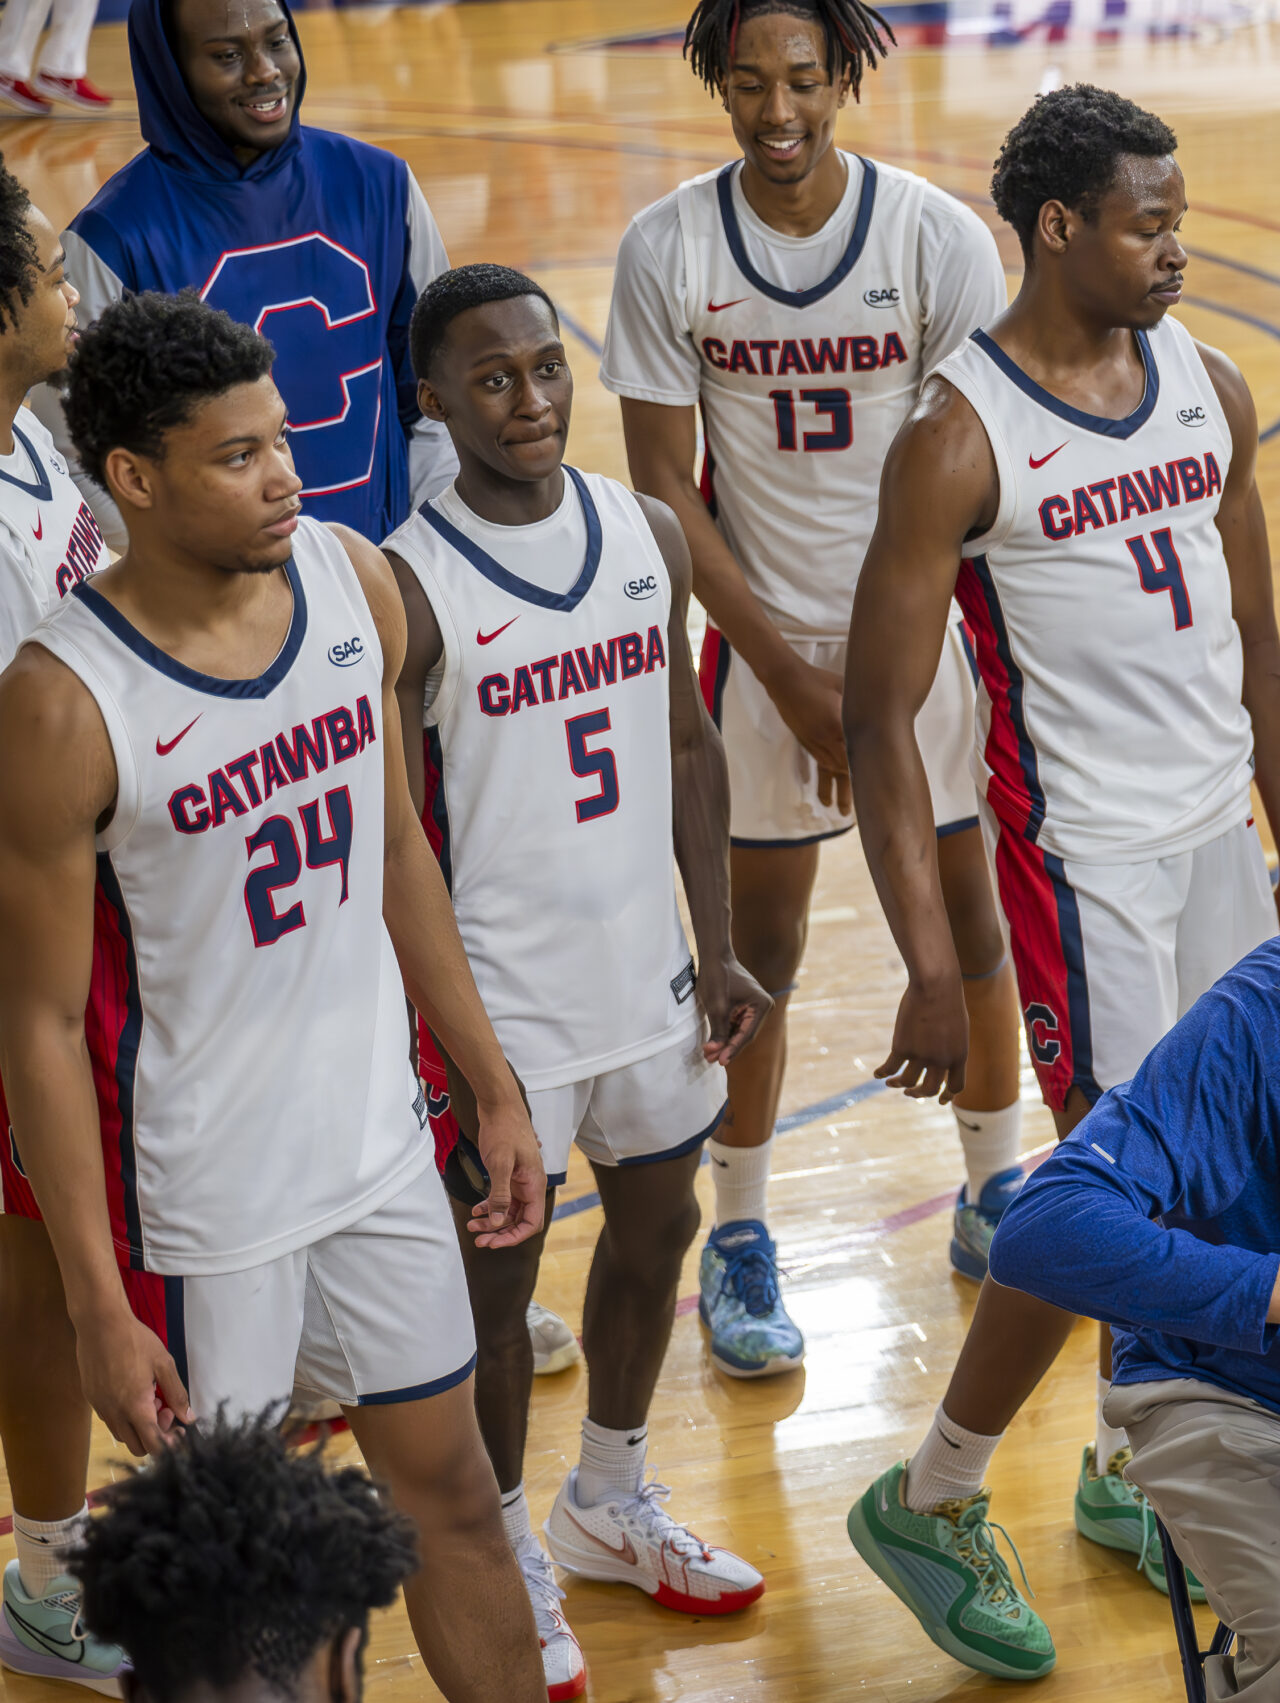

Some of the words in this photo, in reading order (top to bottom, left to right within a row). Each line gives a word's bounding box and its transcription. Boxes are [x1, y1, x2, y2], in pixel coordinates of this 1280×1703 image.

[869, 288, 900, 303] SAC
[702, 332, 908, 376] CATAWBA
[769, 388, 853, 452] 13
[1180, 406, 1205, 422] SAC
[1038, 452, 1221, 541] CATAWBA
[628, 575, 657, 595] SAC
[1125, 527, 1193, 631] 4
[332, 636, 364, 662] SAC
[477, 625, 666, 717] CATAWBA
[167, 694, 376, 834] CATAWBA
[565, 707, 620, 824] 5
[244, 784, 353, 948] 24
[1025, 1002, 1061, 1065] C
